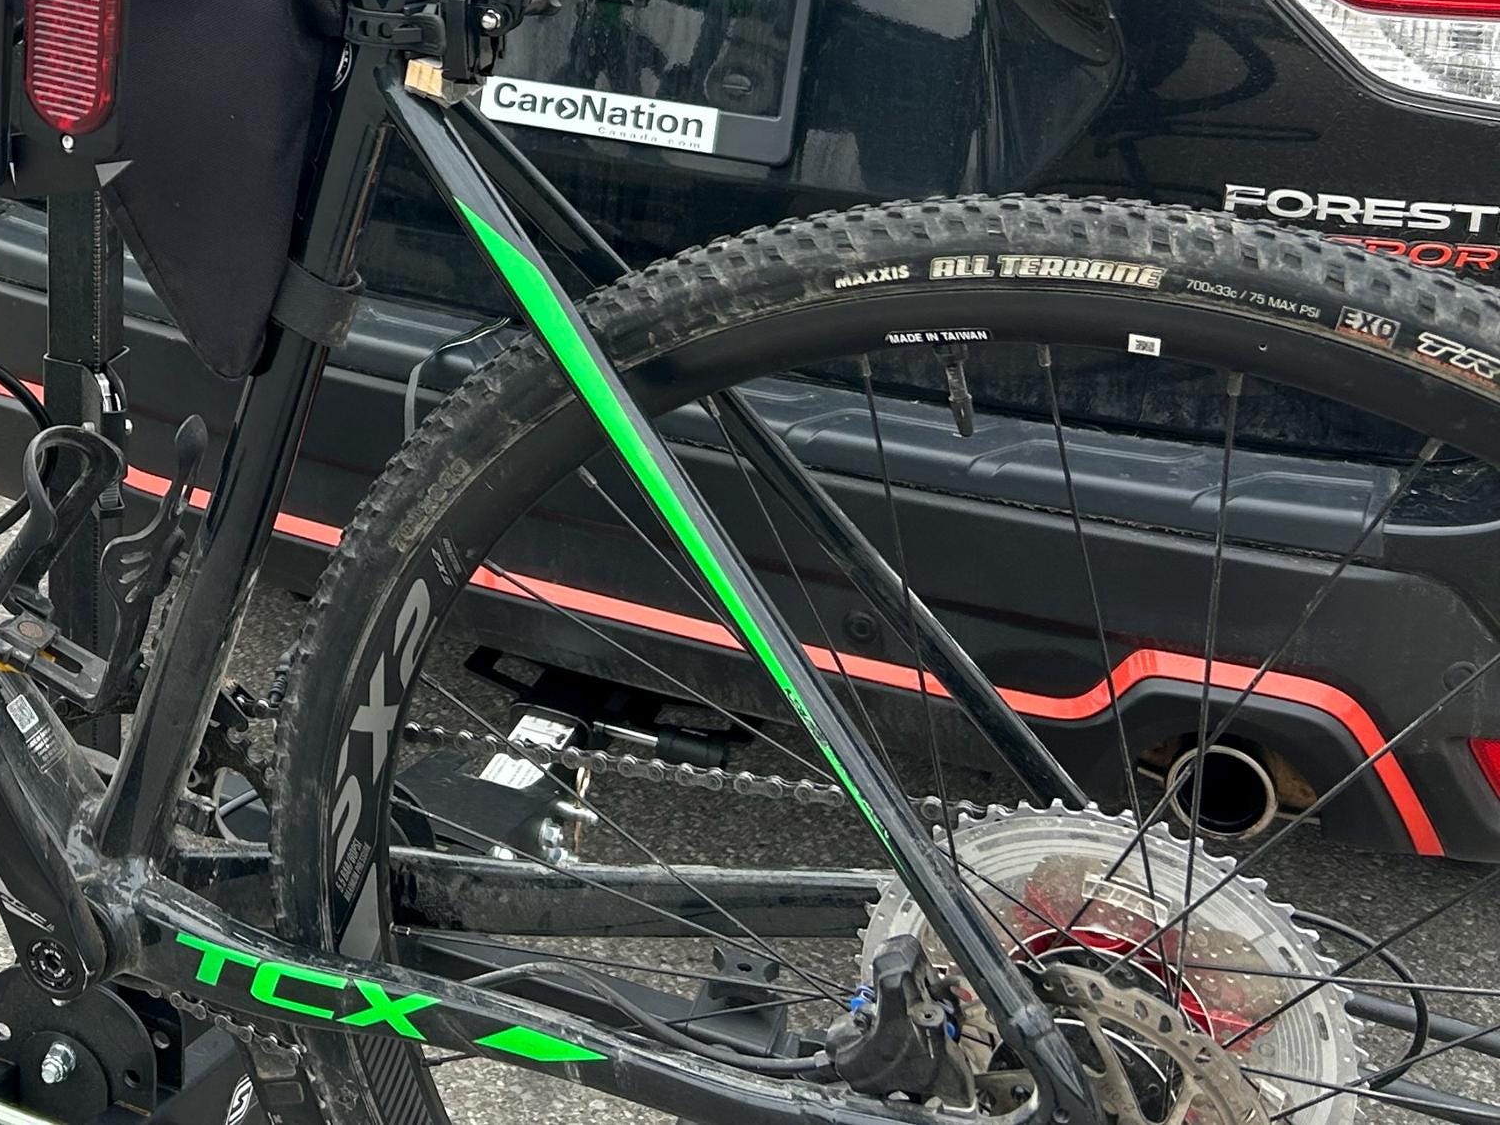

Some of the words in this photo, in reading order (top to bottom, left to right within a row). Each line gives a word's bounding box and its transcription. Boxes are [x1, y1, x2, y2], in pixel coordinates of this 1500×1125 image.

[835, 265, 910, 290] MAXXIS
[929, 255, 996, 280] ALL
[997, 255, 1167, 289] TERRANE
[1249, 292, 1265, 306] 75
[1268, 295, 1297, 313] MAX
[1299, 303, 1321, 319] PSI
[888, 333, 923, 345] MADE
[926, 333, 940, 343] IN
[942, 330, 988, 342] TAIWAN
[175, 932, 444, 1041] TCX
